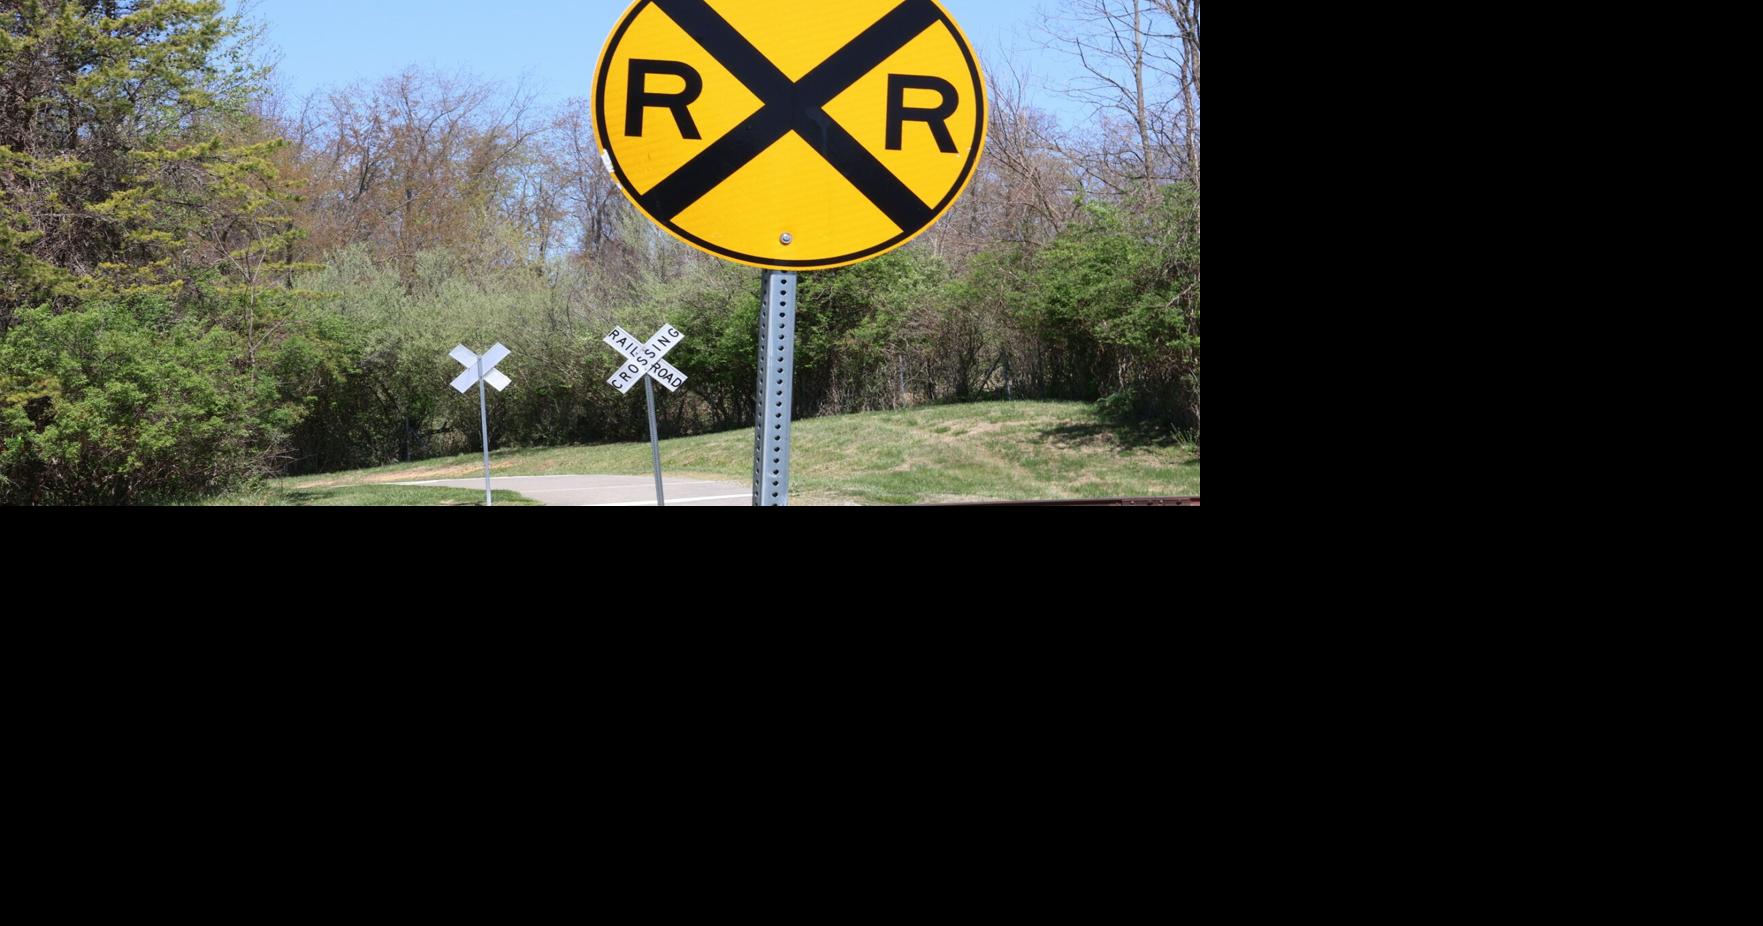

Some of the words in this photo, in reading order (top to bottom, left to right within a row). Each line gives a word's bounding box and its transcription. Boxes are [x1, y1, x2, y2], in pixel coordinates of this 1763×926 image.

[624, 58, 703, 141] R
[885, 73, 959, 154] R
[608, 329, 638, 357] RAIL
[650, 362, 682, 388] ROAD
[611, 328, 680, 389] CROSSING
